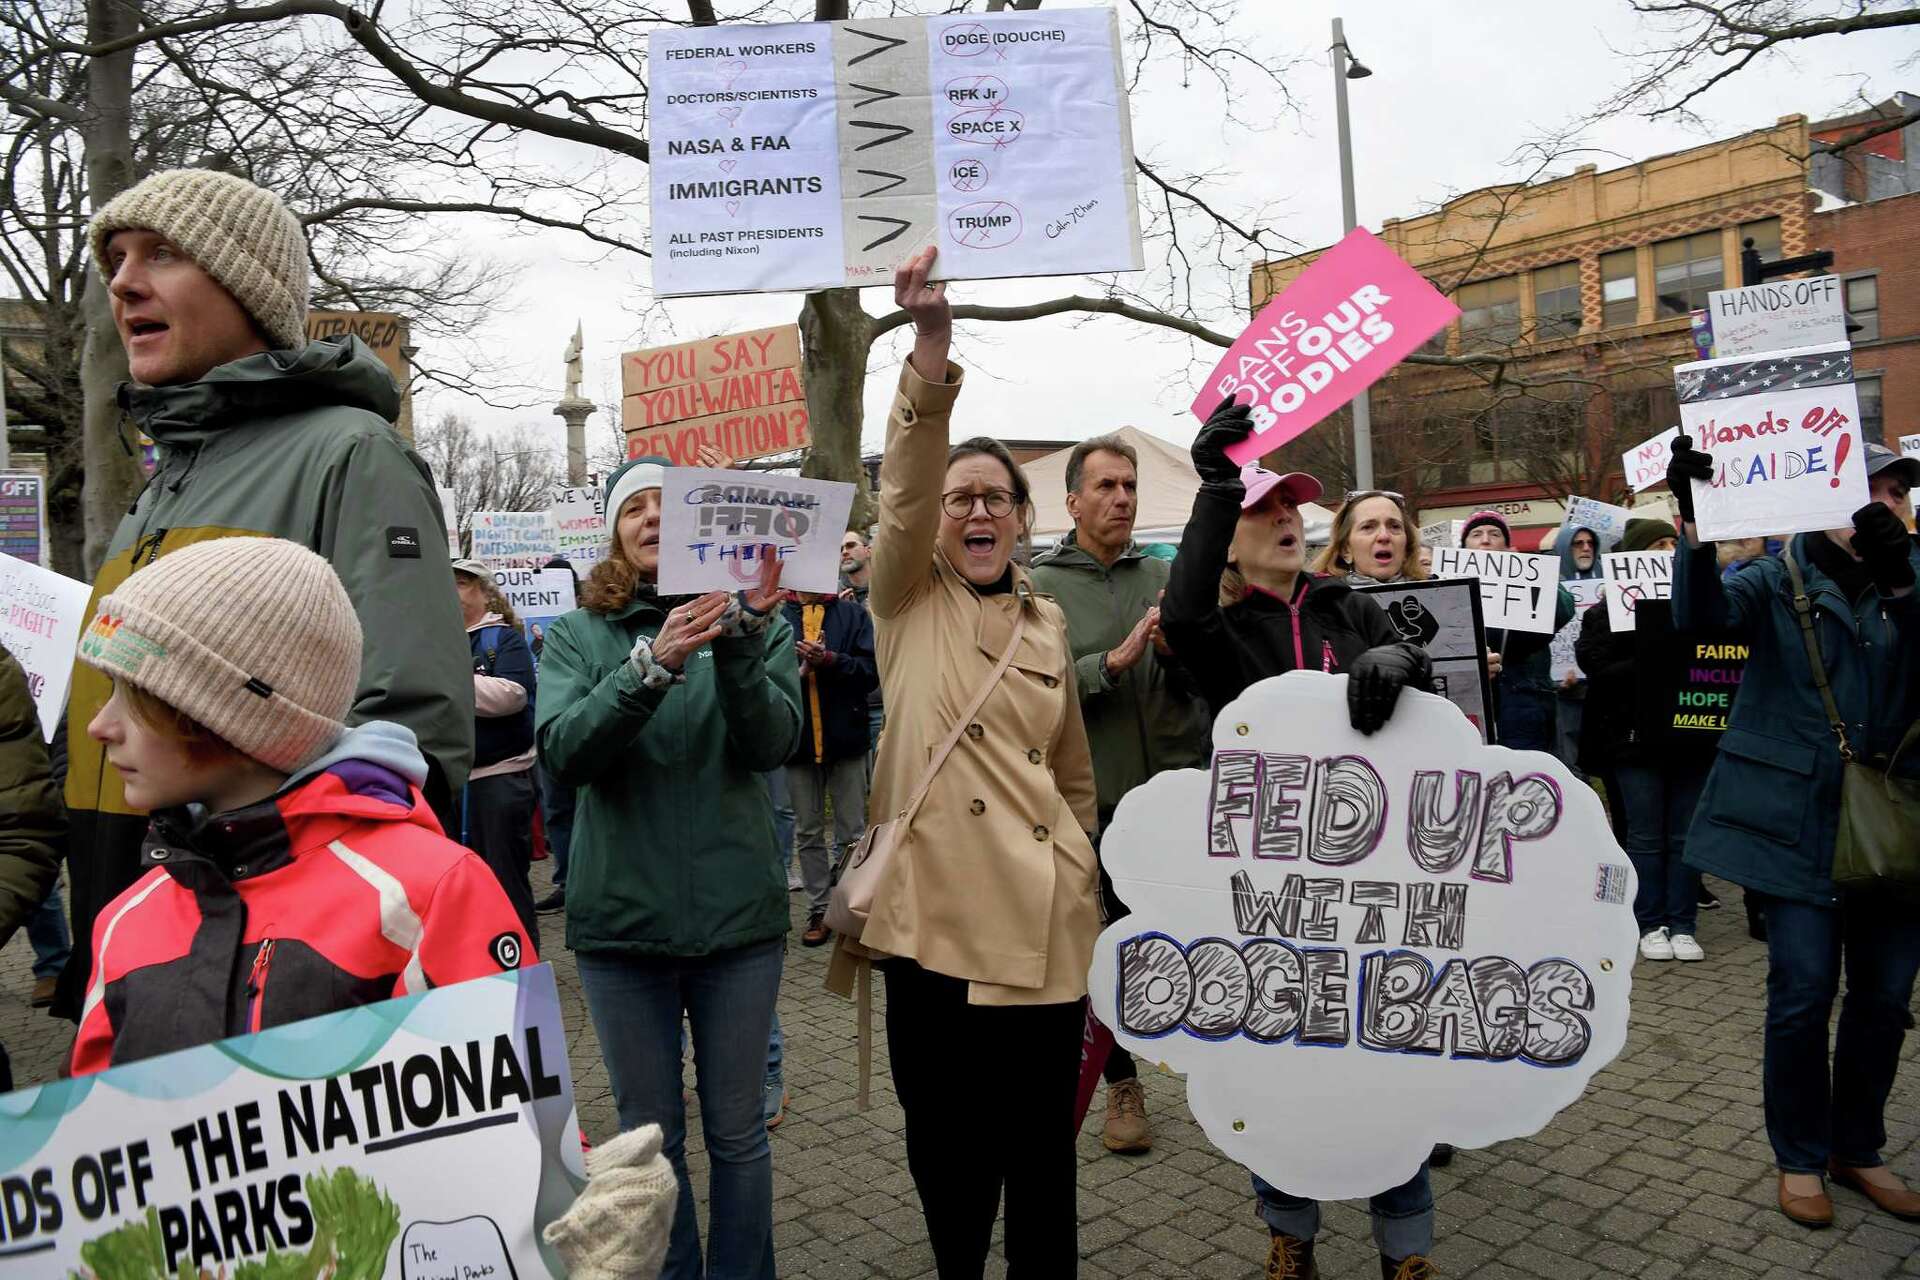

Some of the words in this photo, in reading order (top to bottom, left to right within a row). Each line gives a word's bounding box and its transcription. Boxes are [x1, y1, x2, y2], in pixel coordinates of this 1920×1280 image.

[945, 33, 989, 46] DOGE
[993, 30, 1066, 45] (DOUCHE)
[666, 47, 735, 60] FEDERAL
[738, 42, 816, 57] WORKERS
[667, 88, 818, 105] DOCTORS/SCIENTISTS
[949, 88, 979, 101] RFK
[983, 88, 998, 100] Jr
[951, 120, 1005, 135] SPACE
[1009, 120, 1021, 132] X
[668, 138, 724, 156] NASA
[732, 137, 745, 153] &
[751, 135, 791, 152] FAA
[953, 166, 979, 178] ICE
[669, 176, 823, 200] IMMIGRANTS
[956, 216, 1012, 229] TRUMP
[669, 233, 696, 245] ALL
[700, 231, 734, 243] PAST
[738, 227, 824, 241] PRESIDENTS
[669, 246, 722, 260] (including
[725, 244, 760, 256] Nixon)
[1720, 284, 1793, 316] HANDS
[1795, 278, 1837, 305] OFF
[1217, 310, 1308, 399] BANS
[1232, 348, 1297, 408] OFF
[1296, 284, 1392, 356] OUR
[632, 348, 696, 387] YOU
[710, 333, 775, 373] SAY
[1247, 313, 1395, 435] BODIES
[639, 382, 698, 425] YOU
[701, 371, 777, 413] WANT
[779, 367, 801, 400] A
[1699, 411, 1790, 449] Hands
[1639, 442, 1663, 464] NO
[552, 489, 576, 504] WE
[1441, 549, 1540, 581] HANDS
[1610, 557, 1676, 580] HAN
[1696, 644, 1749, 660] FAIRN
[1678, 691, 1729, 707] HOPE
[1673, 713, 1717, 727] MAKE
[1208, 749, 1388, 866] FED
[1407, 769, 1563, 884] UP
[1230, 869, 1468, 949] WITH
[72, 1139, 153, 1221] OFF
[171, 1101, 268, 1192] THE
[277, 1026, 561, 1158] NATIONAL
[159, 1173, 314, 1274] PARKS
[409, 1243, 437, 1264] The
